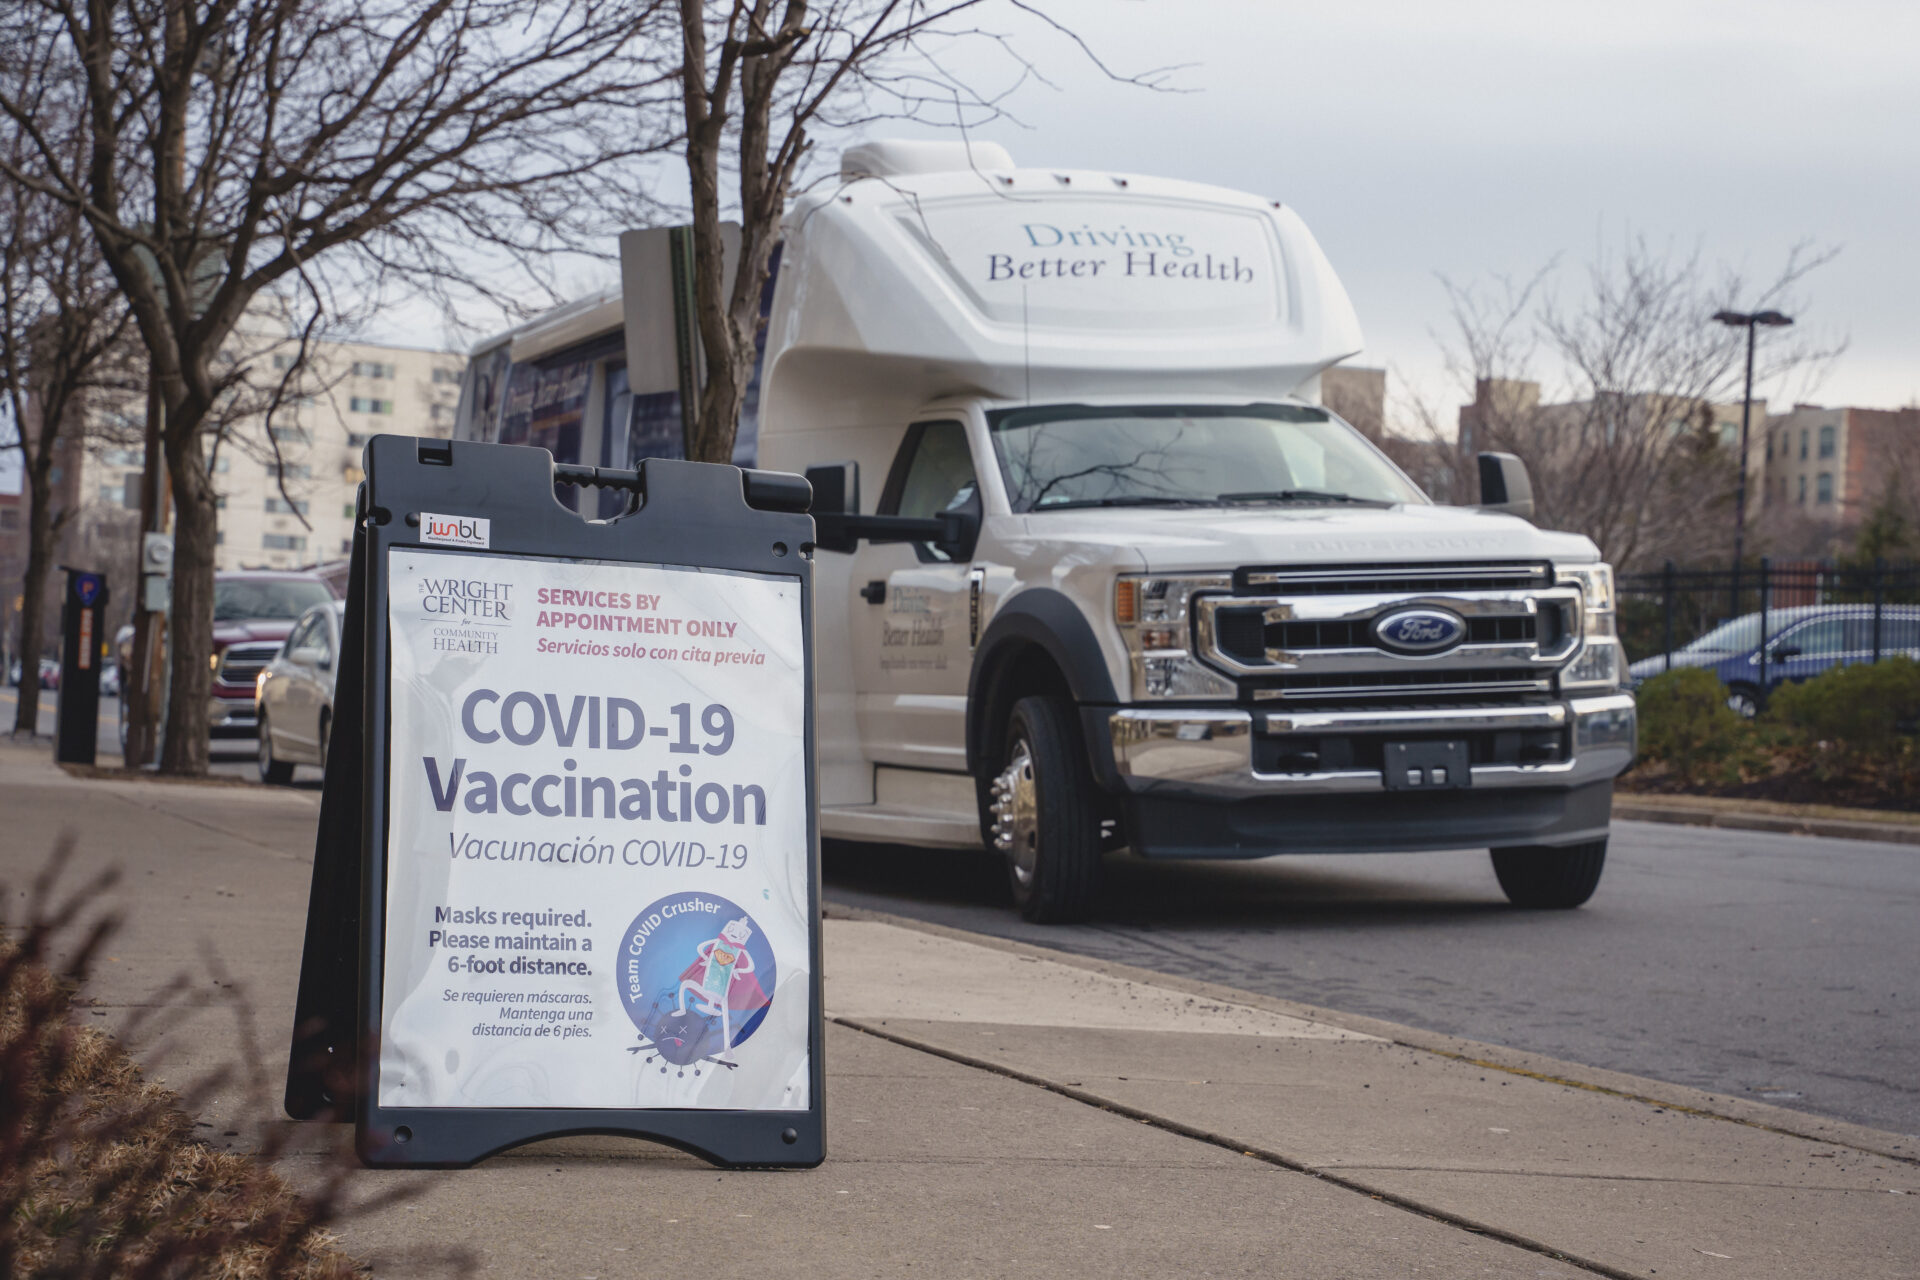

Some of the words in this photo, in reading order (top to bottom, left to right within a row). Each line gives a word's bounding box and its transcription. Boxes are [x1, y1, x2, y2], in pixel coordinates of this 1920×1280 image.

[1021, 223, 1194, 257] Driving
[987, 253, 1106, 282] Better
[1123, 251, 1253, 283] Health
[424, 578, 513, 600] WRIGHT
[537, 588, 632, 609] SERVICES
[636, 594, 661, 611] BY
[423, 595, 511, 620] CENTER
[434, 627, 498, 640] COMMUNITY
[461, 618, 472, 626] for
[536, 611, 682, 635] APPOINTMENT
[686, 620, 737, 638] ONLY
[1398, 617, 1444, 642] Ford
[433, 638, 498, 654] HEALTH
[537, 638, 610, 656] Servicios
[612, 642, 646, 658] solo
[650, 649, 678, 660] con
[681, 646, 711, 662] cita
[713, 649, 766, 666] previa
[461, 689, 735, 756] COVID-19
[422, 756, 767, 826] Vaccination
[450, 832, 615, 864] Vacunación
[622, 839, 748, 869] COVID-19
[435, 906, 497, 925] Masks
[502, 908, 592, 930] required.
[661, 898, 721, 918] Crusher
[429, 930, 490, 949] Please
[495, 931, 577, 951] maintain
[581, 938, 592, 951] a
[629, 914, 662, 956] COVID
[448, 955, 505, 974] 6-foot
[509, 956, 592, 976] distance.
[628, 959, 643, 1004] Team
[443, 989, 459, 1002] Se
[461, 990, 524, 1005] requieren
[527, 990, 592, 1004] máscaras.
[499, 1007, 565, 1023] Mantenga
[568, 1010, 593, 1020] una
[472, 1023, 532, 1037] distancia
[534, 1024, 550, 1037] de
[553, 1025, 561, 1037] 6
[563, 1025, 592, 1040] pies.
